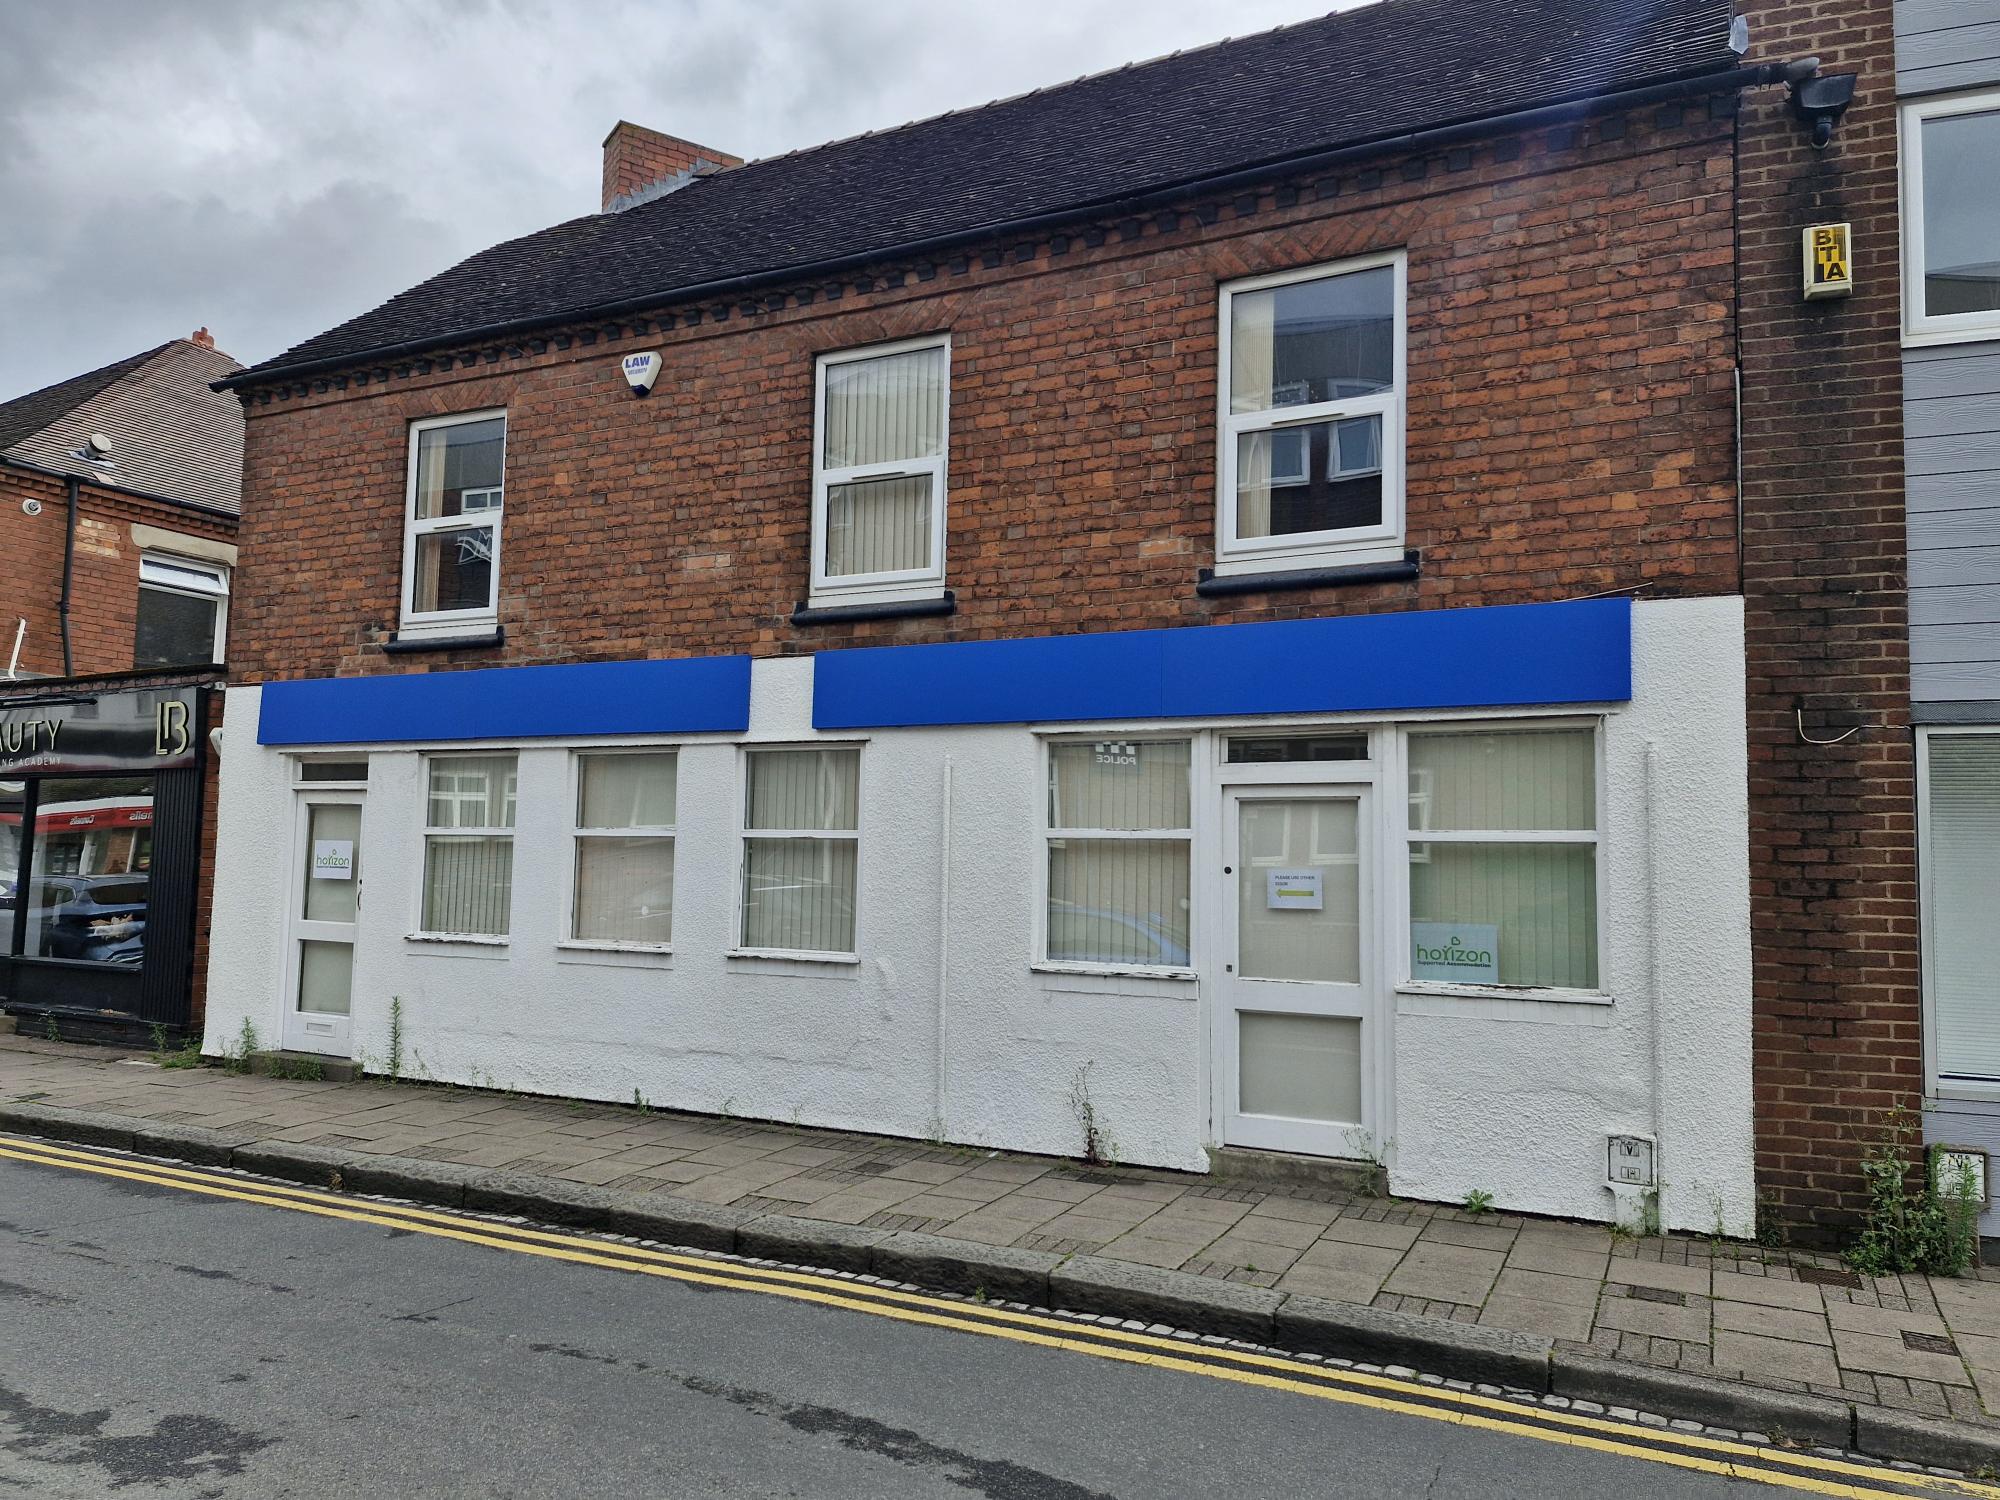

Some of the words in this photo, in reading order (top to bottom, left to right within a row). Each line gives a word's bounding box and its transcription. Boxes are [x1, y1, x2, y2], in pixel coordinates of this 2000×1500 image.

[625, 355, 650, 368] LAW
[0, 719, 62, 752] UTY
[18, 757, 61, 767] ACADEMY
[316, 853, 350, 866] horizon
[1416, 944, 1491, 963] horizon
